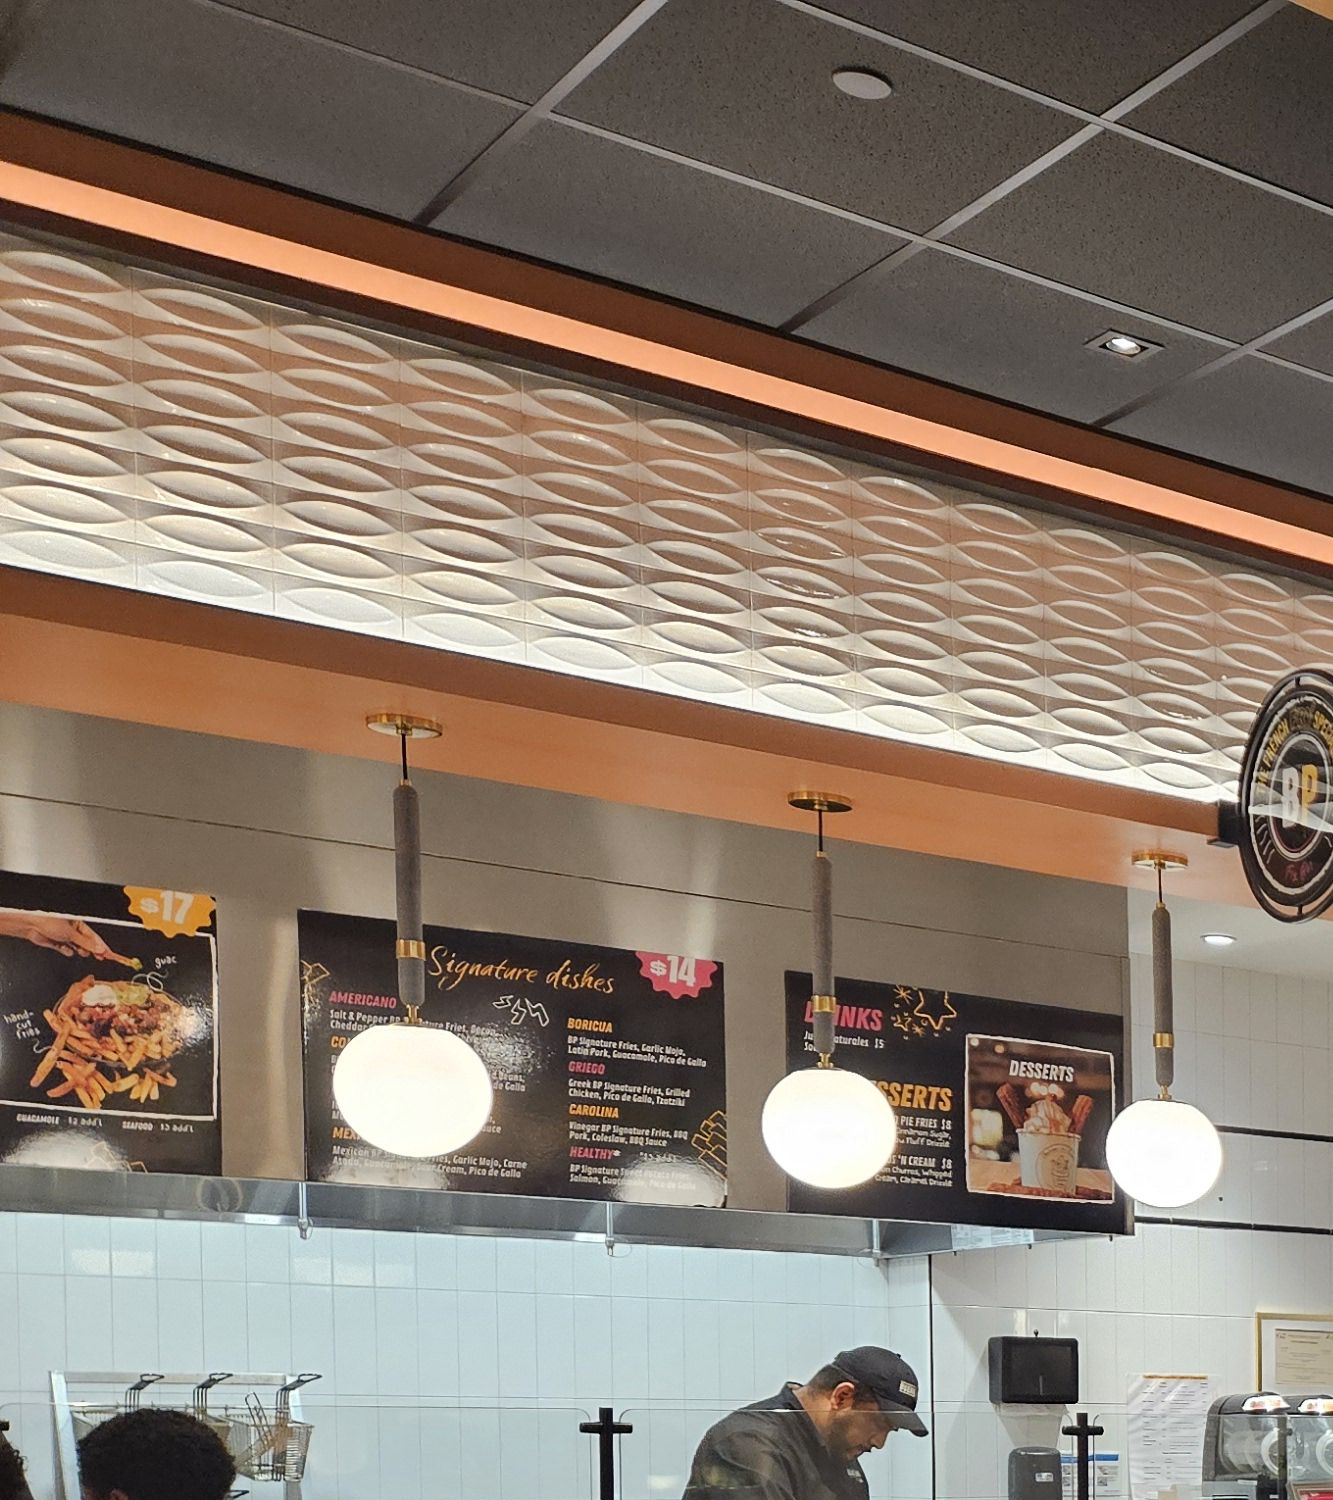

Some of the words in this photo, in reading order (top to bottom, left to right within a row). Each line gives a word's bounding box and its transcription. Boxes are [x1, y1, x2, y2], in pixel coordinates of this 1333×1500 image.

[1263, 718, 1290, 768] FRENCH
[140, 889, 193, 925] $17
[155, 956, 177, 969] guac
[428, 945, 539, 991] Signature
[546, 960, 616, 995] dishes
[649, 955, 697, 988] $14
[328, 991, 397, 1009] AMERICANO
[4, 1009, 34, 1024] hand-
[330, 1009, 347, 1020] Salt
[348, 1011, 355, 1021] &
[356, 1012, 388, 1025] Pepper
[804, 1000, 884, 1031] DINKS
[16, 1021, 33, 1030] cut
[330, 1019, 369, 1032] Cheddar
[567, 1017, 613, 1033] BORICUA
[567, 1035, 578, 1044] BP
[579, 1036, 618, 1049] Signature
[618, 1041, 640, 1052] Fries,
[641, 1043, 664, 1054] Garlic
[833, 1035, 869, 1047] aturales
[567, 1045, 589, 1056] Latin
[590, 1047, 611, 1059] Pork,
[612, 1050, 658, 1064] Guacamole,
[659, 1055, 675, 1064] Pico
[676, 1057, 686, 1066] de
[687, 1057, 707, 1068] Gallo
[568, 1061, 606, 1075] GRIEGO
[1009, 1059, 1075, 1082] DESSERTS
[505, 1082, 526, 1092] Gallo
[568, 1078, 591, 1088] Greek
[592, 1080, 603, 1089] BP
[604, 1081, 642, 1094] Signature
[642, 1085, 664, 1096] Fries,
[665, 1088, 690, 1098] Grilled
[568, 1088, 602, 1101] Chicken,
[603, 1091, 620, 1101] Pico
[621, 1092, 632, 1102] de
[632, 1093, 655, 1105] Gallo,
[872, 1079, 953, 1112] SSERTS
[568, 1103, 619, 1118] CAROLINA
[481, 1125, 502, 1134] auce
[900, 1115, 914, 1126] PIE
[915, 1117, 937, 1128] FRIES
[568, 1121, 599, 1133] Vinegar
[601, 1124, 612, 1132] BP
[612, 1124, 650, 1137] Signature
[651, 1128, 672, 1139] Fries,
[673, 1129, 689, 1140] BBQ
[569, 1130, 590, 1142] Pork,
[592, 1133, 628, 1145] Coleslaw,
[629, 1136, 644, 1146] BBQ
[645, 1137, 668, 1147] Sauce
[453, 1155, 478, 1165] Garlic
[503, 1159, 528, 1169] Carne
[908, 1156, 936, 1167] CREAM
[437, 1164, 467, 1175] Cream,
[468, 1166, 486, 1176] Pico
[488, 1168, 499, 1177] de
[500, 1169, 522, 1178] Gallo
[569, 1163, 580, 1173] BP
[581, 1164, 619, 1177] Signature
[569, 1173, 601, 1185] Salmon,
